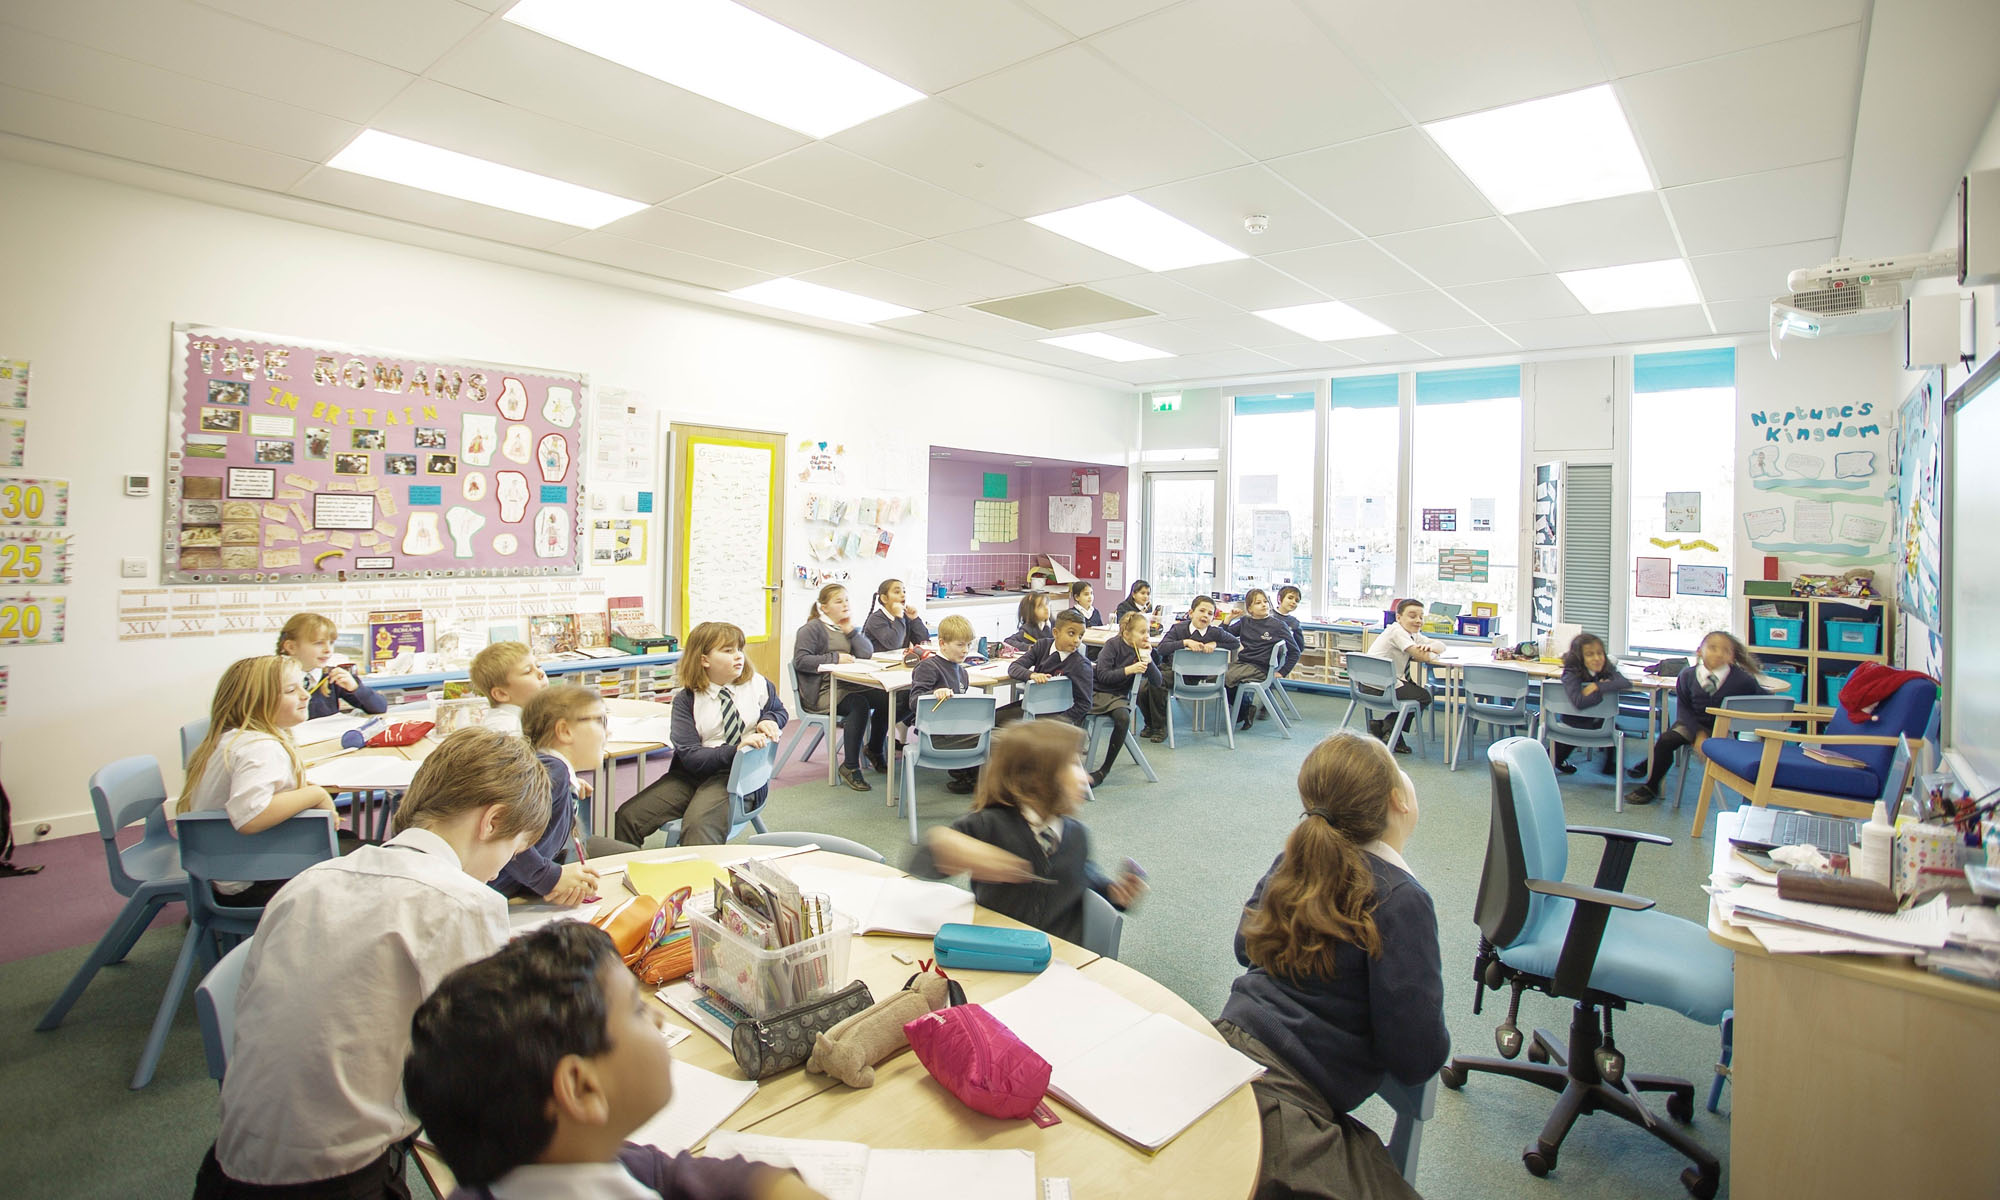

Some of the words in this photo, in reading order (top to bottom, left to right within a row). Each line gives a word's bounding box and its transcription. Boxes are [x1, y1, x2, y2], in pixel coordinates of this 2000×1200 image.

[192, 341, 293, 381] THE
[312, 355, 488, 402] ROMANS
[264, 386, 300, 411] IN
[311, 402, 439, 426] BRITAIN
[1750, 401, 1874, 427] Neptune's
[1765, 421, 1880, 444] Kingdom
[1, 485, 44, 519] 30
[0, 545, 42, 578] 25
[464, 584, 478, 595] IX
[499, 584, 508, 594] X
[528, 583, 541, 593] XI
[556, 582, 573, 593] XII
[583, 581, 601, 592] XIII
[231, 592, 249, 603] III
[274, 591, 292, 602] IV
[319, 590, 330, 600] V
[356, 590, 372, 600] VI
[392, 588, 411, 598] VII
[424, 587, 448, 598] VIII
[188, 593, 200, 605] II
[457, 607, 484, 618] XXII
[488, 605, 517, 617] XXIII
[520, 604, 547, 615] XXIV
[552, 602, 574, 613] XXV
[425, 608, 448, 619] XXI
[0, 605, 42, 639] 20
[127, 621, 160, 634] XIV
[180, 619, 207, 631] XV
[224, 616, 255, 628] XVI
